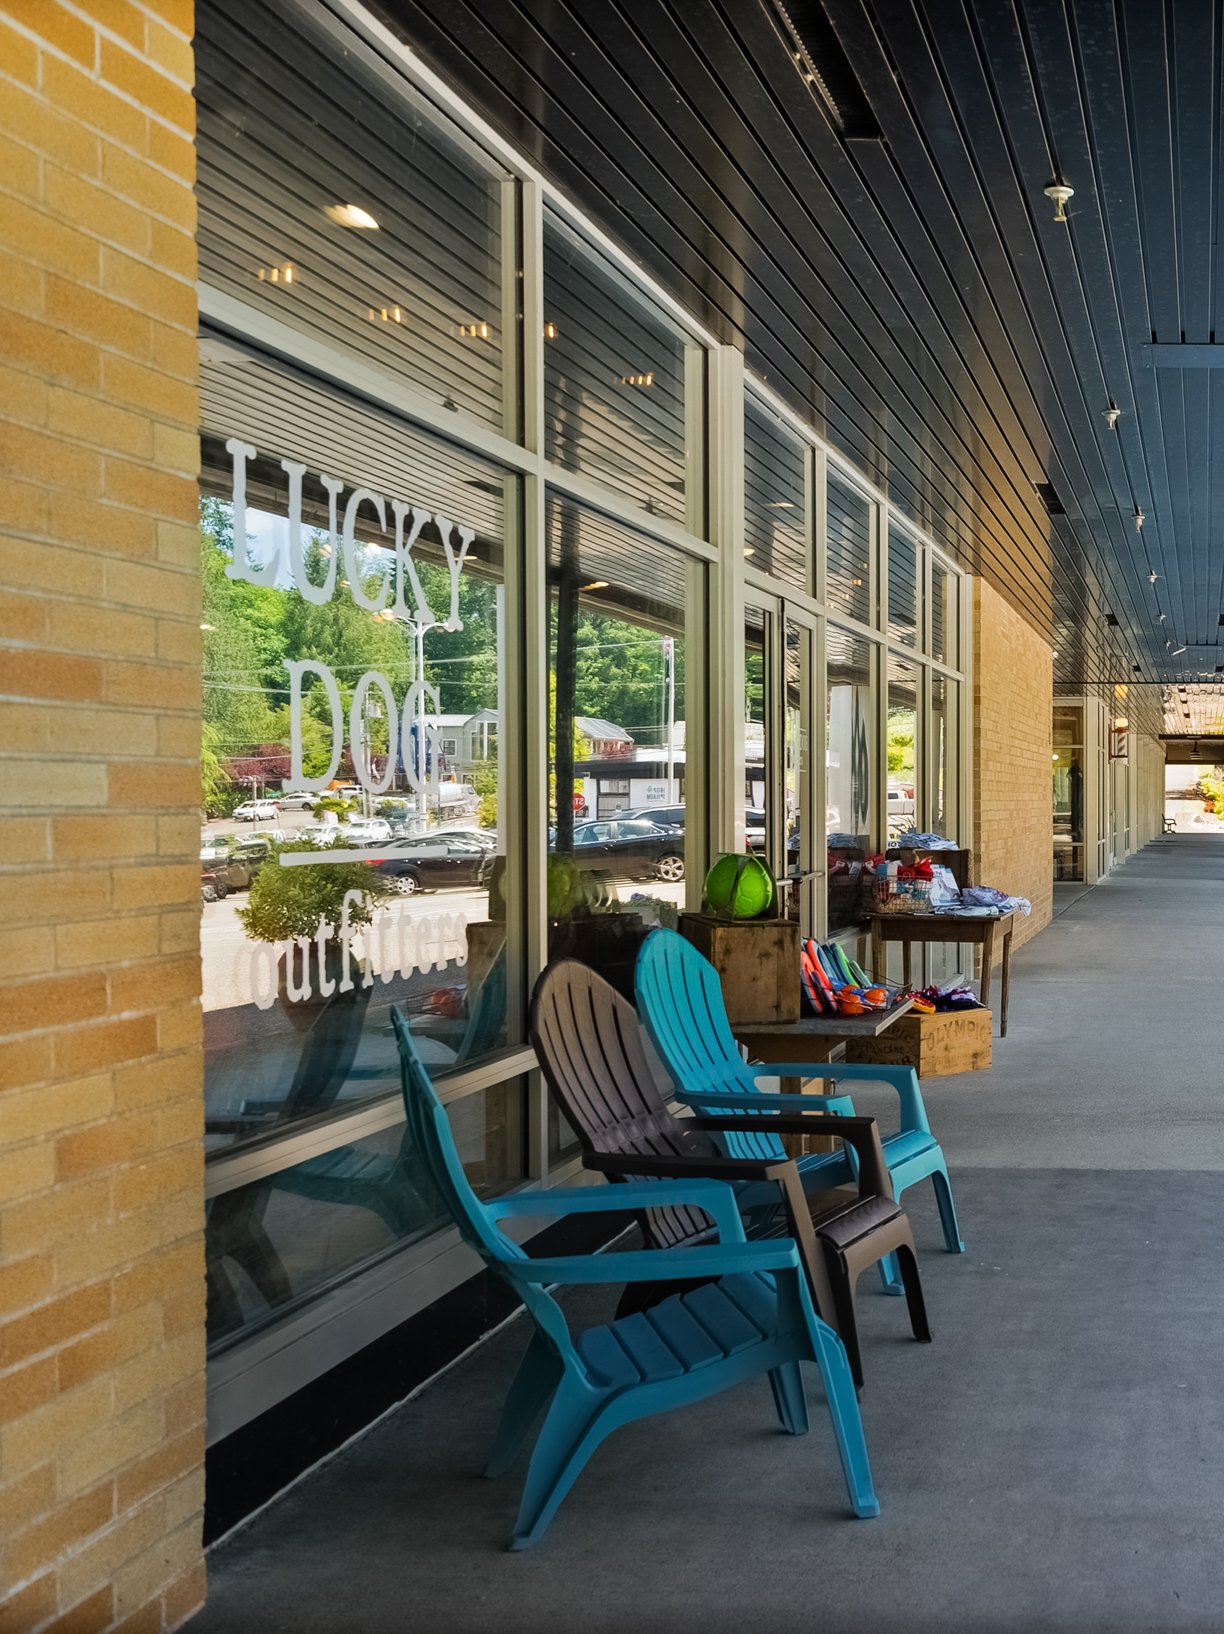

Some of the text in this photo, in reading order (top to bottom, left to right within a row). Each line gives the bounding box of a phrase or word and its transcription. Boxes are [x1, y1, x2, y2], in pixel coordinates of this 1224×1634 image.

[225, 438, 475, 631] LUCKY
[282, 658, 442, 796] DOG
[249, 889, 469, 1011] outfitters
[927, 1020, 989, 1051] OLYMPIC
